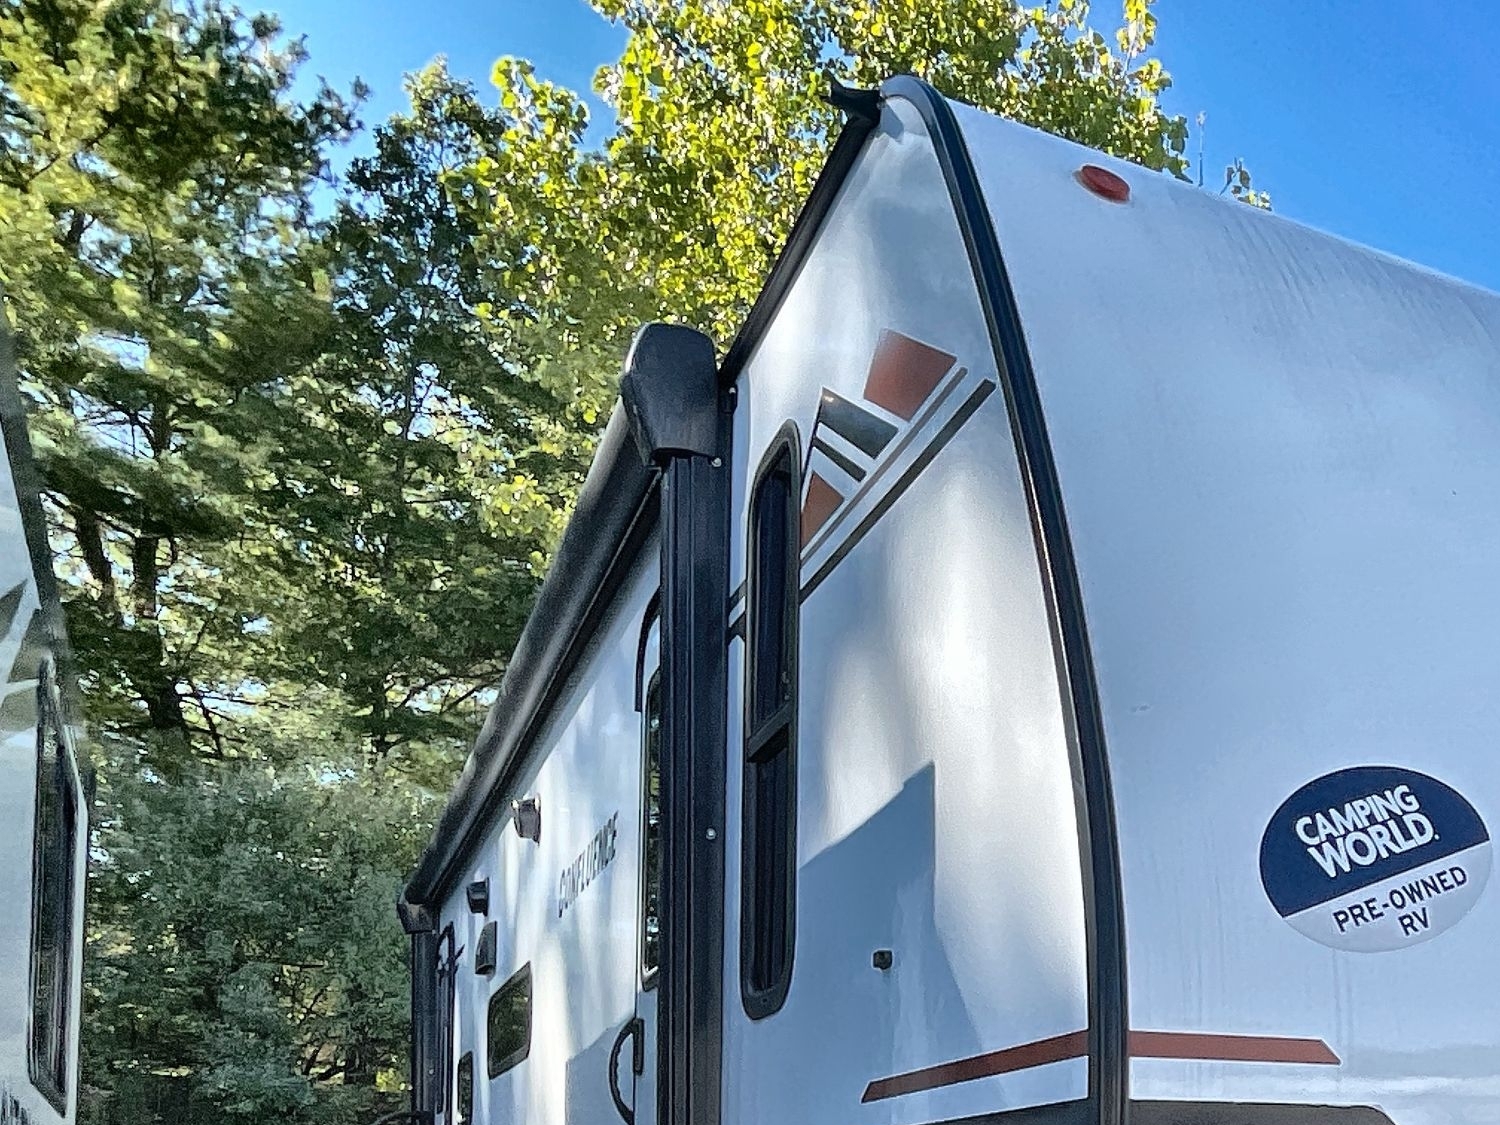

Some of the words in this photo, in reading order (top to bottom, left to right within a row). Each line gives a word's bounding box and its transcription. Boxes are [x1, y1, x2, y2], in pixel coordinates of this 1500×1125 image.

[1295, 784, 1420, 846] CAMPING
[1333, 866, 1468, 933] PRE-OWNED
[1398, 907, 1430, 936] RV
